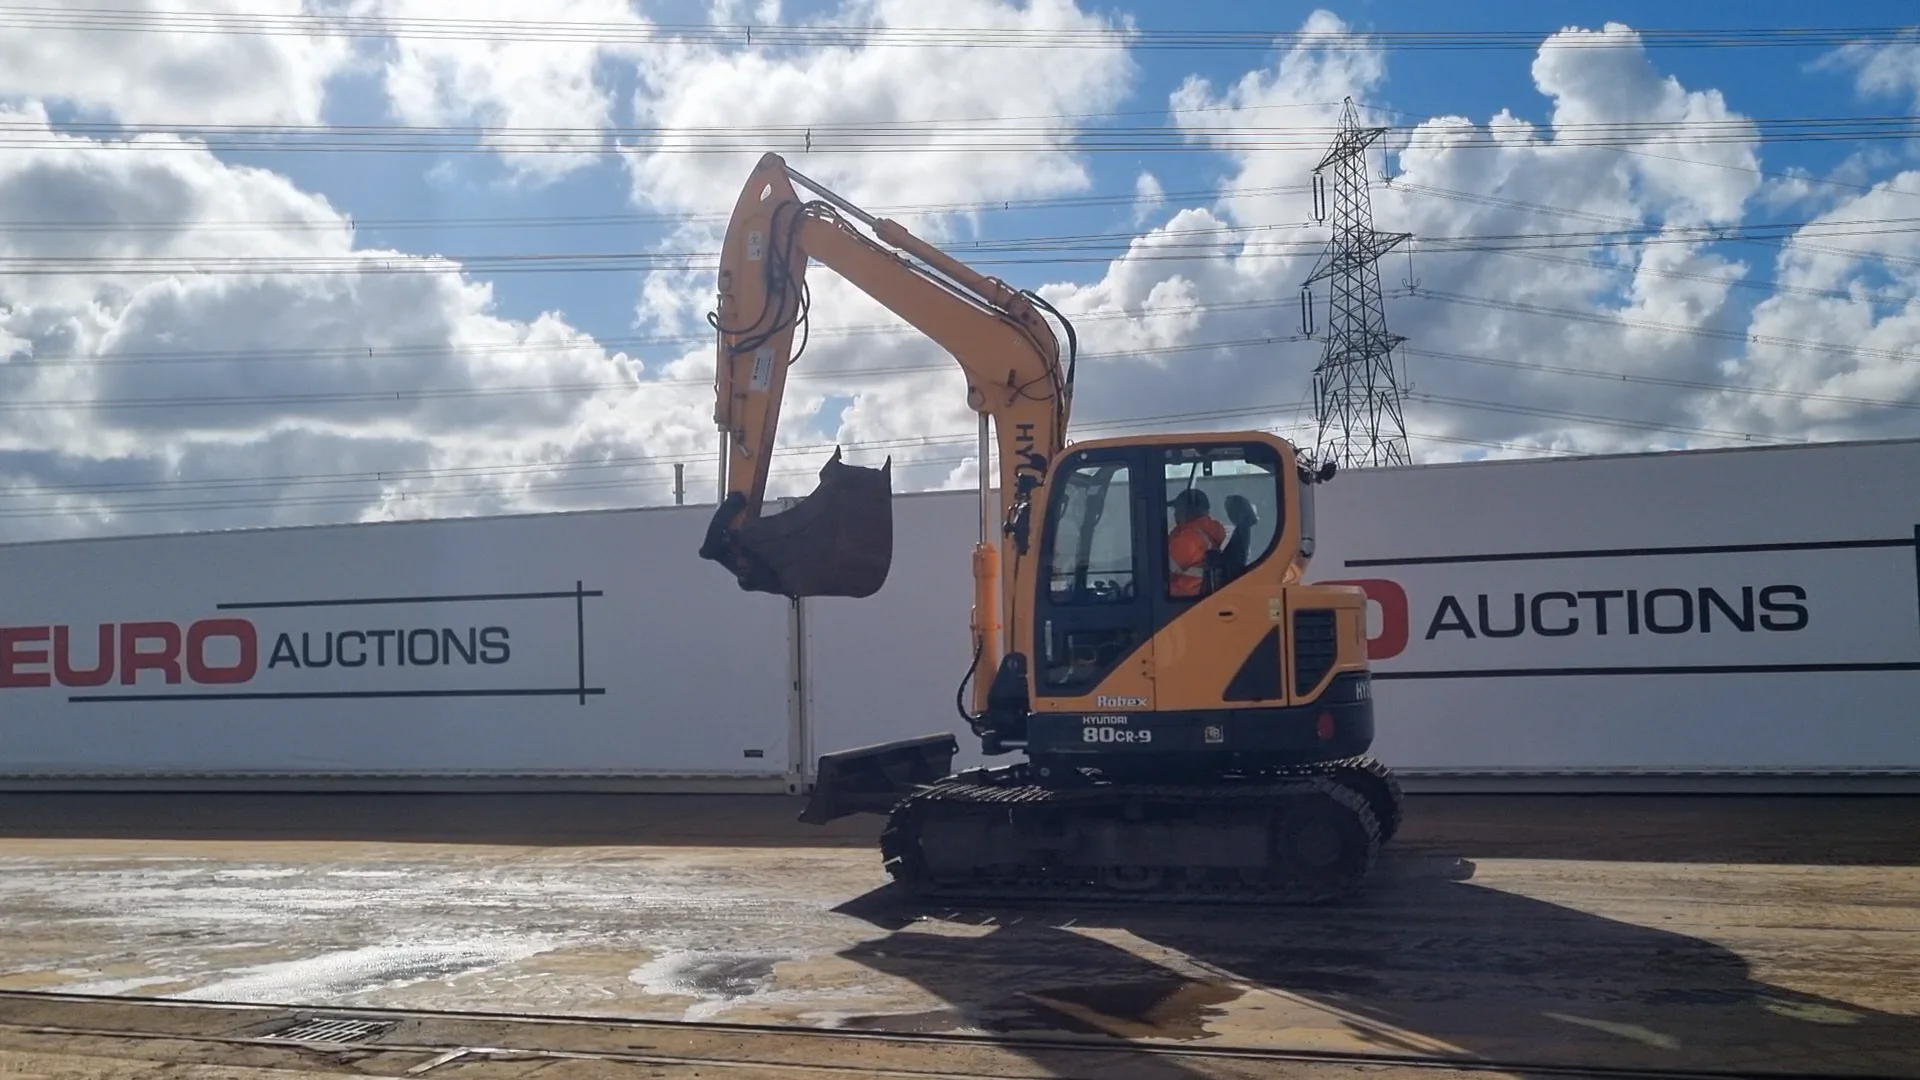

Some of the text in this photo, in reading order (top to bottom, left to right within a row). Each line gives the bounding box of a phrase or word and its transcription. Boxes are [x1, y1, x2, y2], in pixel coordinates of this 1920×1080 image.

[1424, 584, 1809, 640] AUCTIONS
[0, 618, 511, 688] EURO AUCTIONS
[1097, 695, 1148, 708] Robex
[1082, 715, 1128, 725] HYUNDAI
[1083, 726, 1152, 743] 80CR-9
